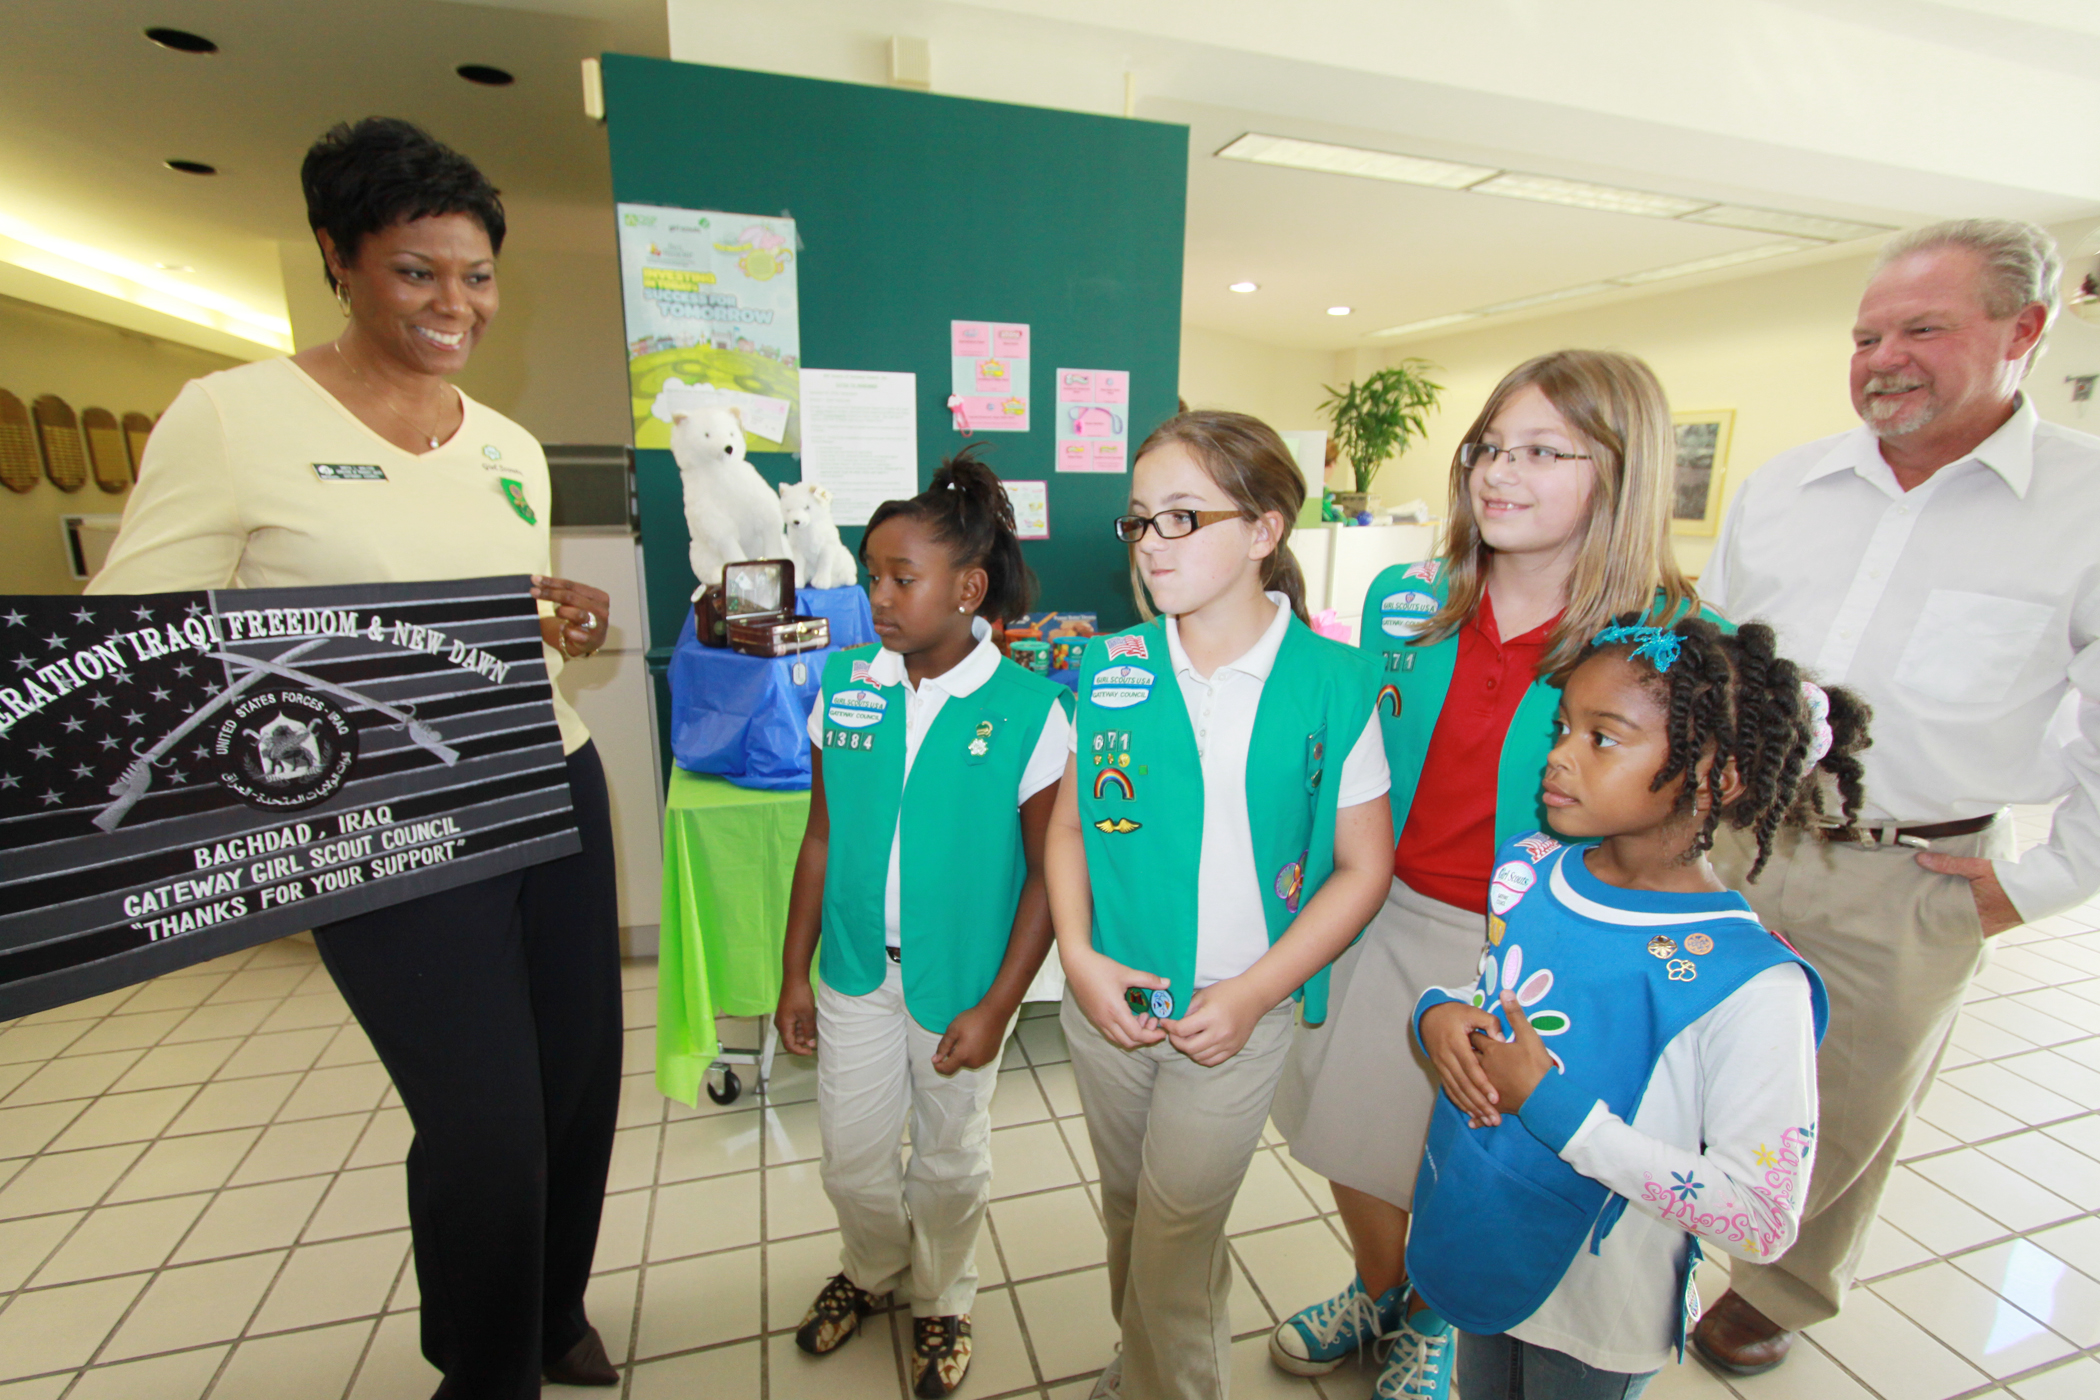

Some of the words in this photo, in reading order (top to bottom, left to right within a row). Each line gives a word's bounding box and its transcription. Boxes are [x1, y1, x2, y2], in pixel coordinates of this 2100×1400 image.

[658, 301, 774, 324] TOMORROW
[125, 614, 222, 662] IRAQI
[225, 608, 359, 639] FREEDOM
[367, 615, 385, 642] &
[391, 619, 446, 655] NEW
[448, 638, 511, 684] DAWN
[1384, 653, 1414, 669] 71
[1096, 676, 1109, 684] GIRL
[1110, 676, 1136, 684] SCOUTS
[829, 710, 854, 718] GATEWAY
[856, 712, 880, 720] COUNCIL
[847, 699, 870, 709] SCOUTS
[215, 719, 238, 755] UNITED
[235, 693, 277, 718] STATES
[281, 691, 325, 711] FORCES
[327, 711, 350, 735] IRAQ
[826, 730, 873, 750] 1384
[1094, 731, 1129, 751] 671
[193, 823, 312, 870] BAGHDAD
[338, 805, 394, 835] IRAQ
[123, 868, 243, 917] GATEWAY
[250, 854, 304, 883] GIRL
[309, 835, 373, 868] SCOUT
[381, 817, 461, 851] COUNCIL
[261, 881, 304, 910] FOR
[310, 864, 365, 894] YOUR
[1641, 1181, 1749, 1242] Scouts
